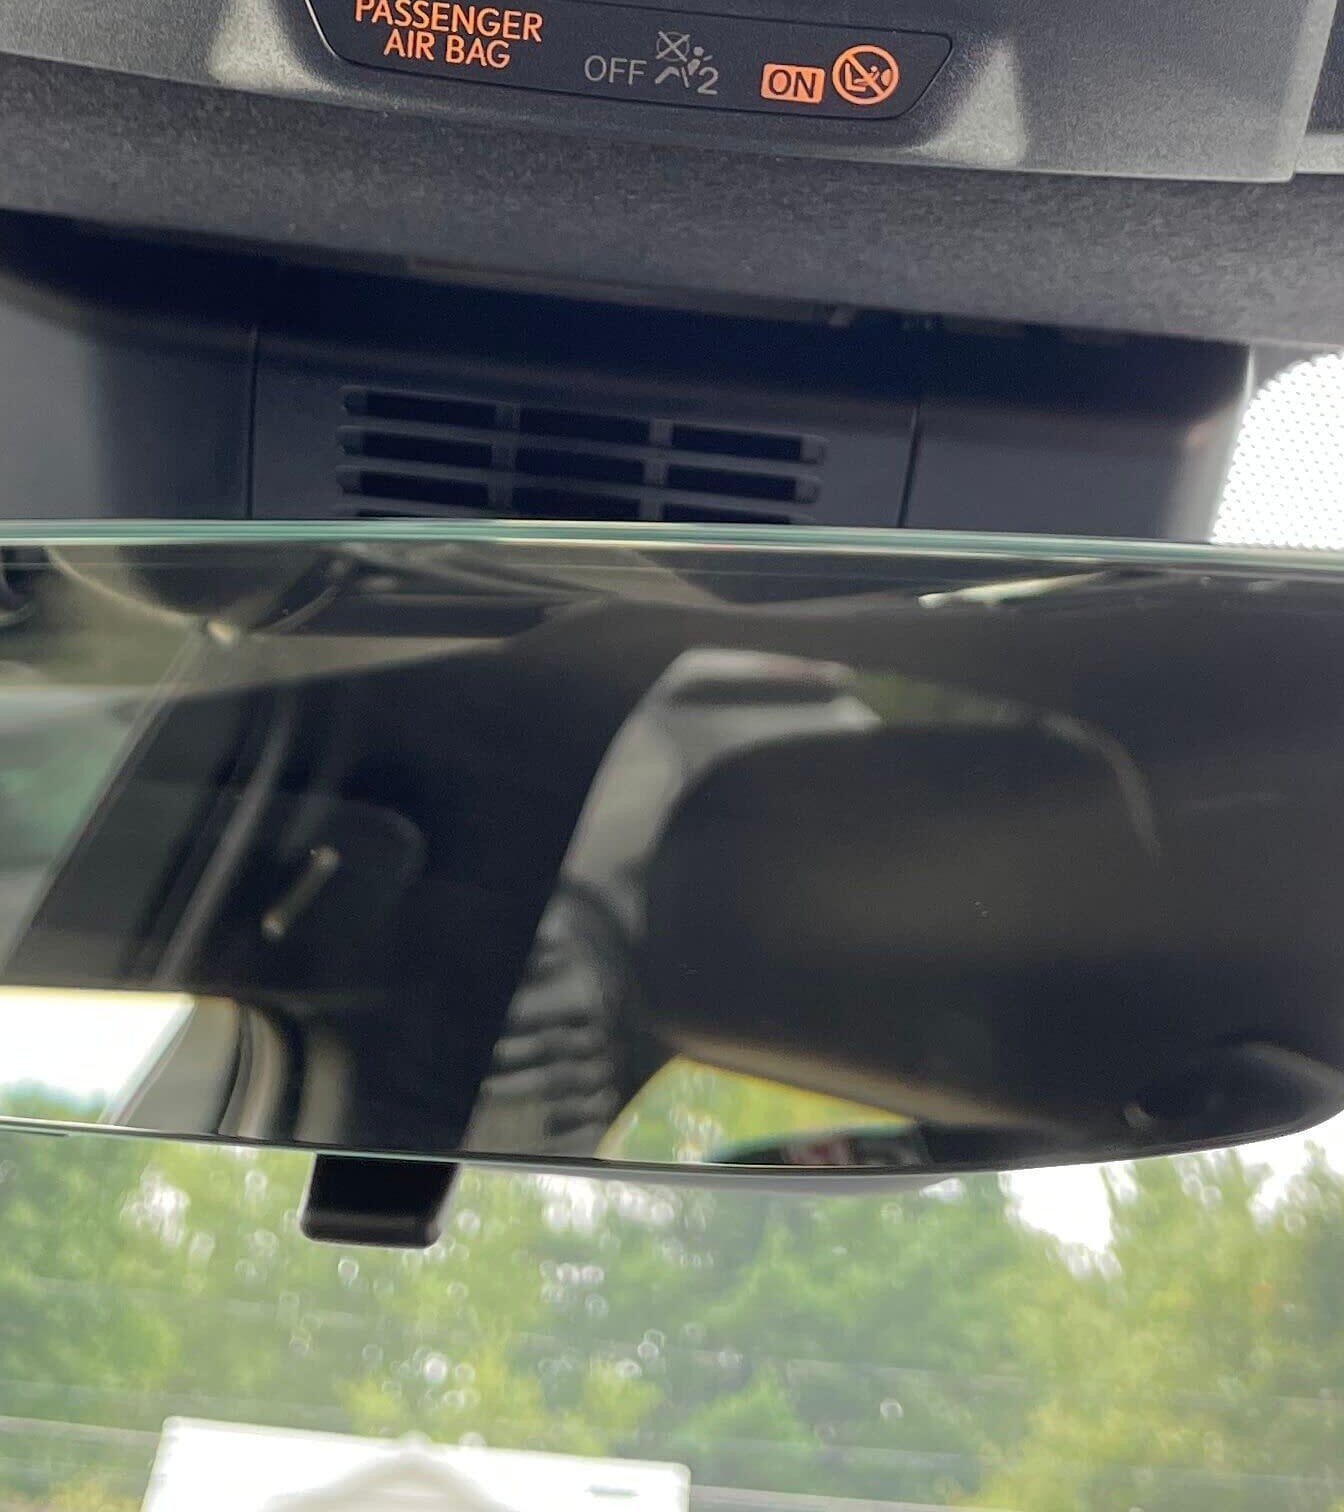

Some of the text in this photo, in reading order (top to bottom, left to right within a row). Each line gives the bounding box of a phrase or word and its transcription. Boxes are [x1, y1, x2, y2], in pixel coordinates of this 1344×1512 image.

[383, 27, 512, 69] AIR BAG
[583, 54, 648, 86] OFF
[696, 66, 720, 96] 2
[767, 68, 817, 99] ON
